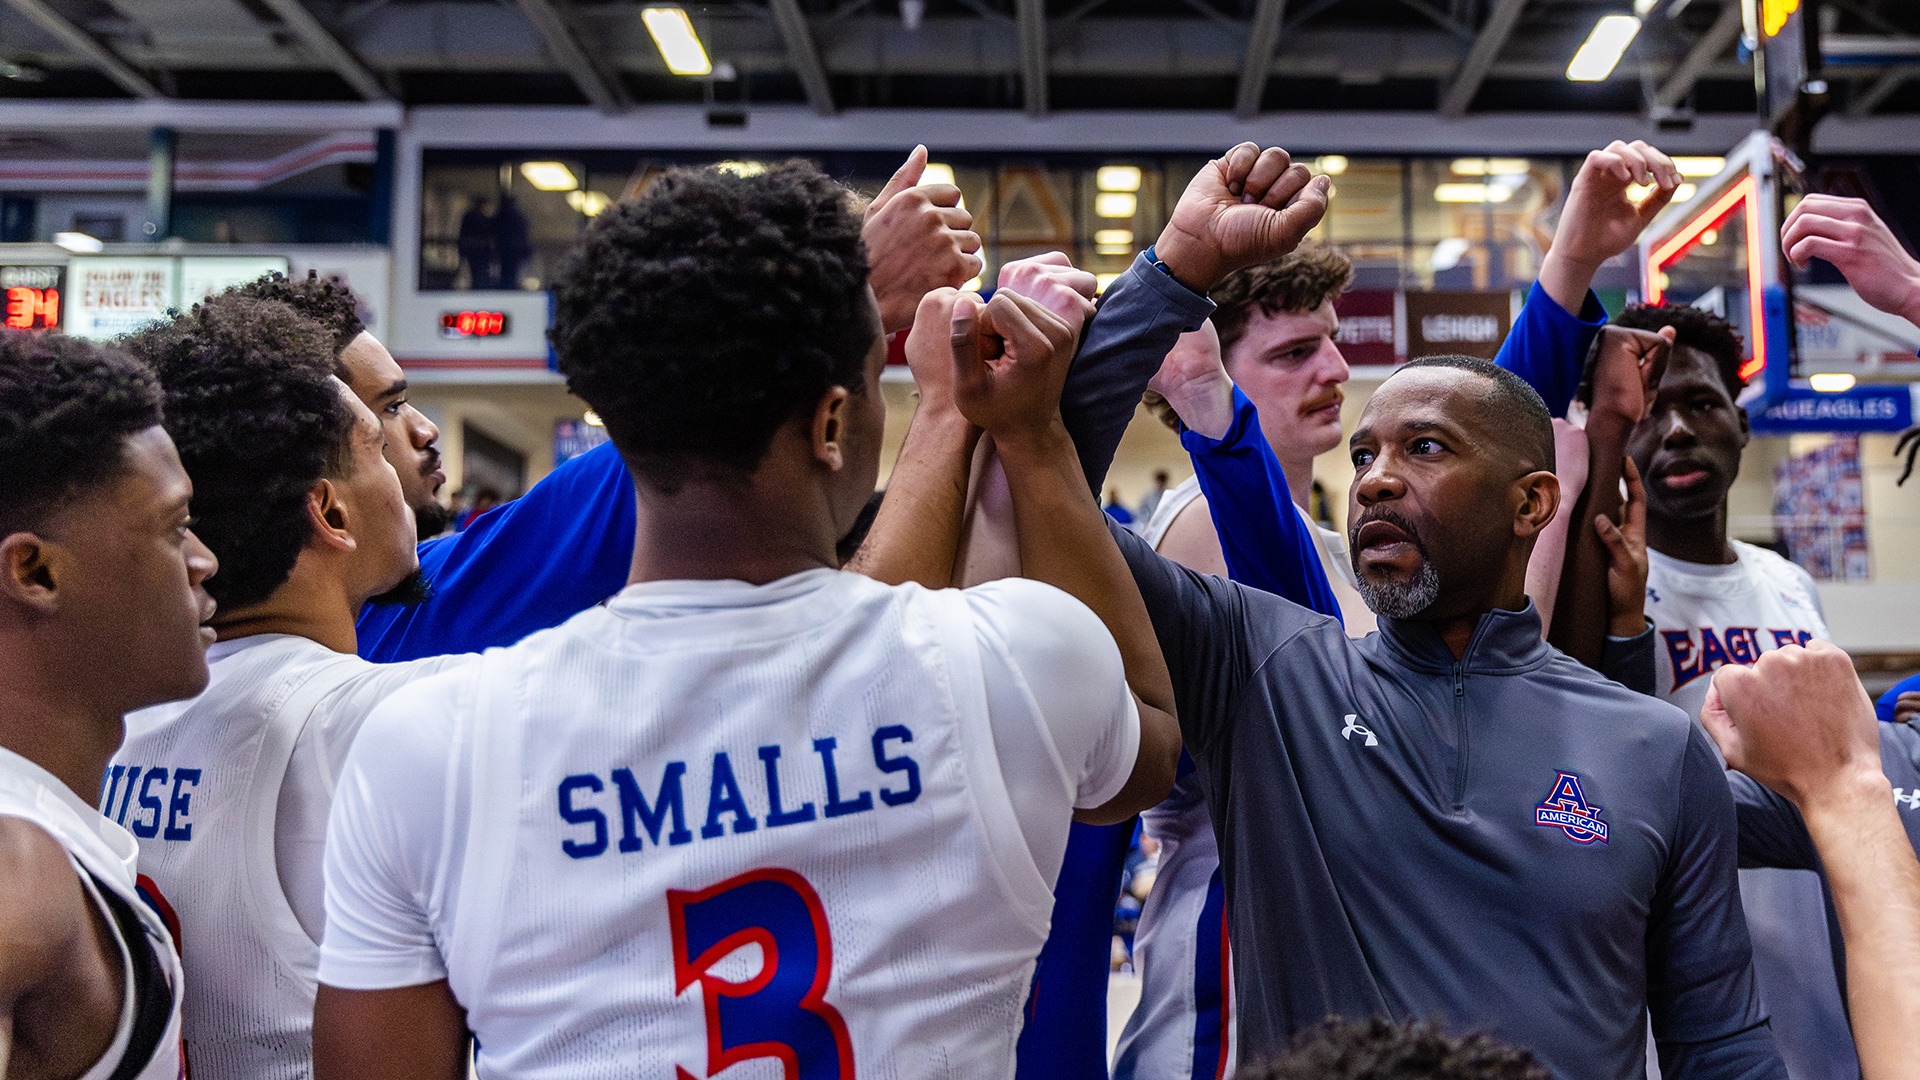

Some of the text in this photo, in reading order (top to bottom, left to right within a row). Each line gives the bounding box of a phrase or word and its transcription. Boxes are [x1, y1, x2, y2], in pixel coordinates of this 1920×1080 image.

[1421, 314, 1499, 342] LEHIGH
[101, 765, 202, 841] USE
[558, 724, 922, 859] SMALLS
[1540, 811, 1604, 834] AMERICAN
[666, 867, 855, 1080] 3
